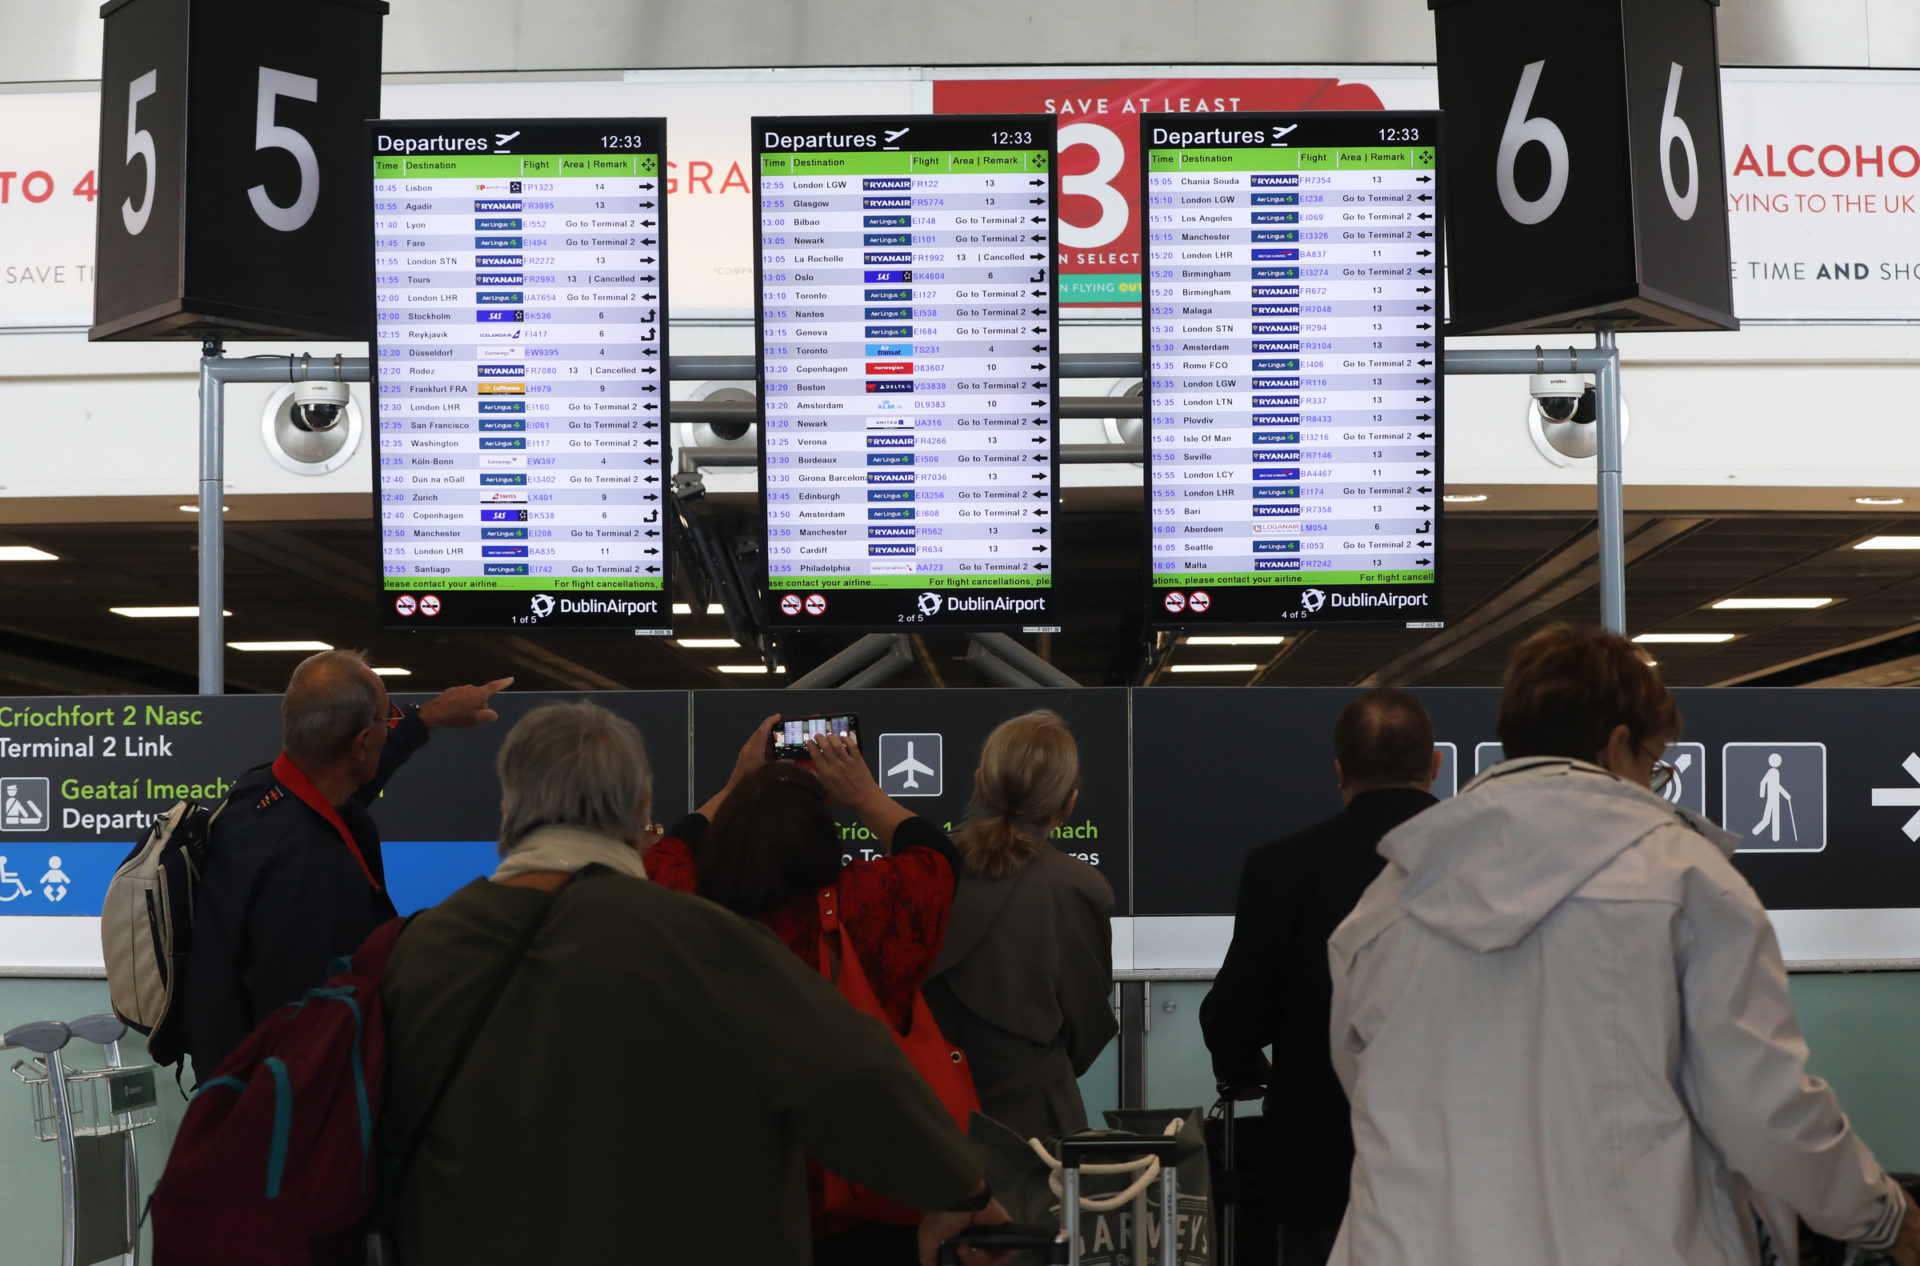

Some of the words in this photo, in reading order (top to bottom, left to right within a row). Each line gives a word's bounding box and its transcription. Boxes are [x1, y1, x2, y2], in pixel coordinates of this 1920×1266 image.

[1045, 98, 1109, 114] SAVE
[1122, 98, 1150, 113] AT
[1165, 98, 1241, 112] LEAST
[377, 136, 488, 154] Departures
[601, 136, 642, 148] 12:33
[765, 132, 876, 151] Departures
[991, 132, 1032, 144] 12:33
[1153, 128, 1264, 147] Departures
[1378, 128, 1419, 141] 12:33
[1496, 59, 1569, 225] 6
[1660, 61, 1699, 221] 6
[121, 68, 157, 236] 5
[247, 66, 320, 232] 5
[377, 162, 398, 170] Time
[406, 161, 456, 170] Destination
[524, 160, 549, 169] Flight
[563, 160, 584, 169] Area
[594, 160, 627, 168] Remark
[764, 158, 785, 167] Time
[794, 158, 844, 167] Destination
[913, 157, 939, 166] Flight
[1152, 155, 1174, 163] Time
[1182, 154, 1233, 163] Destination
[1301, 153, 1326, 163] Flight
[1371, 153, 1405, 161] Remark
[1733, 143, 1920, 178] ALCOHO
[0, 171, 54, 204] TO
[73, 170, 98, 202] 4
[793, 181, 824, 189] London
[1057, 122, 1129, 248] 3
[1213, 177, 1239, 185] Souda
[406, 203, 432, 211] Agadir
[762, 200, 784, 208] 12:55
[794, 200, 829, 208] Glasgow
[1795, 194, 1826, 213] TO
[1832, 194, 1877, 213] THE
[1884, 194, 1916, 214] UK
[407, 257, 436, 265] London
[440, 257, 457, 265] STN
[1078, 253, 1139, 265] SELECT
[6, 265, 65, 284] SAVE
[76, 265, 94, 282] TI
[1748, 262, 1806, 280] TIME
[1816, 262, 1870, 280] AND
[376, 276, 398, 284] 11:55
[408, 276, 430, 284] Tours
[594, 275, 635, 283] Cancelled
[1073, 283, 1115, 293] FLYING
[1152, 417, 1174, 425] 15:35
[1301, 415, 1332, 423] FR8433
[1152, 435, 1174, 443] 15:40
[413, 512, 463, 520] Copenhagen
[800, 546, 827, 554] Cardiff
[572, 580, 594, 589] flight
[597, 580, 658, 588] cancellations,
[947, 578, 969, 586] flight
[972, 578, 1033, 586] cancellations,
[1378, 573, 1399, 582] flight
[561, 599, 657, 616] DublinAirport
[948, 597, 1045, 613] DublinAirport
[1332, 593, 1428, 608] DublinAirport
[907, 614, 914, 622] of
[0, 705, 115, 727] Críochfort
[122, 705, 136, 726] 2
[145, 705, 202, 726] Nasc
[0, 735, 94, 758] Terminal
[102, 737, 116, 757] 2
[125, 735, 173, 757] Link
[61, 779, 140, 800] Geataí
[147, 777, 236, 799] Imeach
